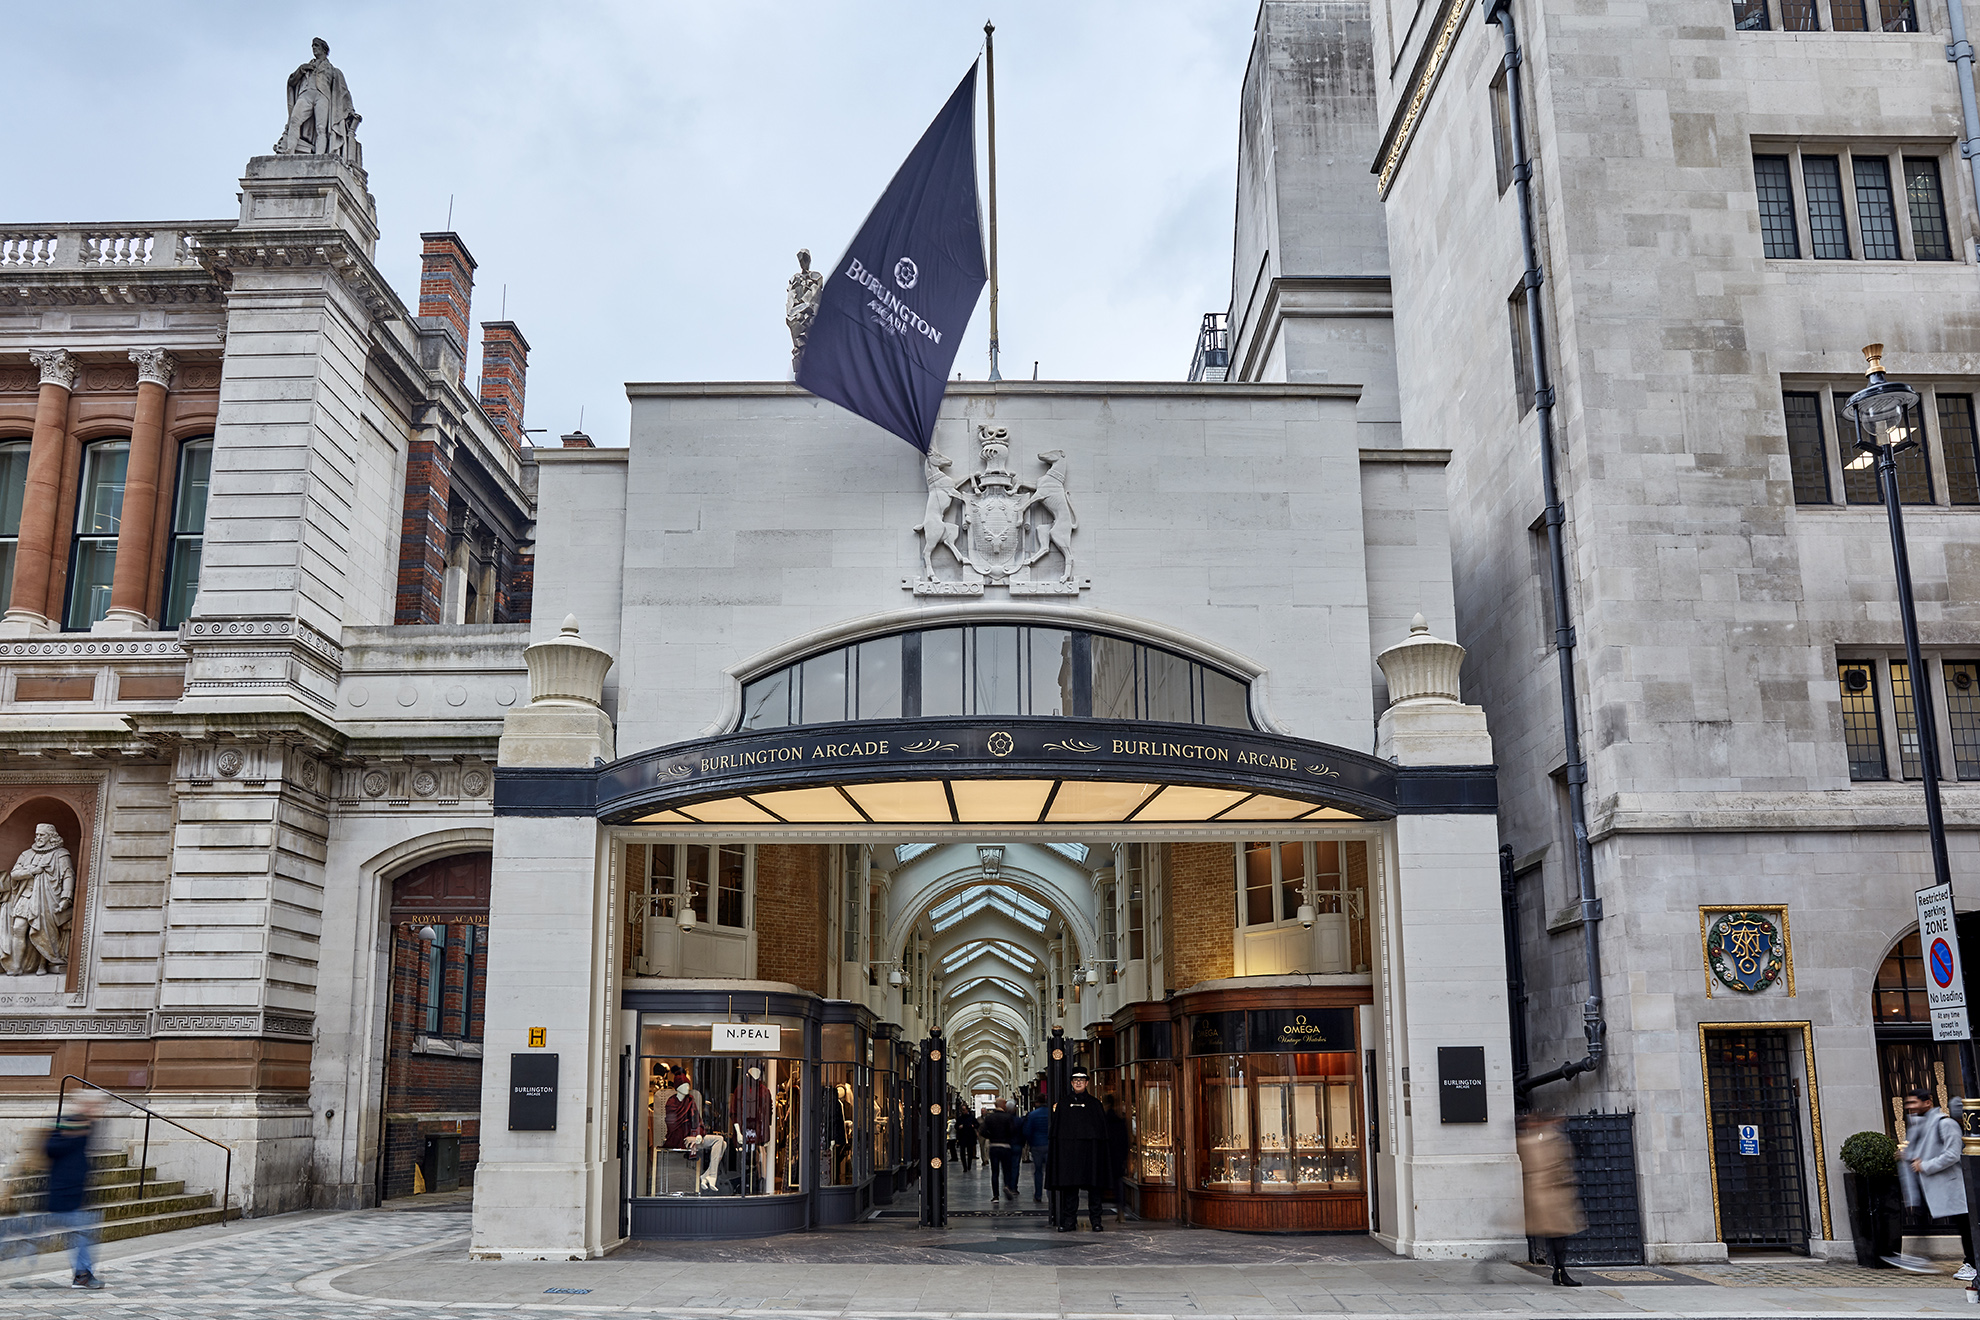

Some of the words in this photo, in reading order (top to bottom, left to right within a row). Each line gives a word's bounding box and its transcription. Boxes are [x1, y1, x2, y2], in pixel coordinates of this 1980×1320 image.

[845, 257, 943, 344] BURLINGTON
[917, 583, 980, 593] CAVENDO
[1016, 583, 1073, 593] TUTUS
[223, 665, 256, 675] DAVY
[700, 746, 803, 773] BURLINGTON
[811, 740, 889, 760] ARCADE
[1112, 739, 1229, 762] BURLINGTON
[1236, 750, 1297, 772] ARCADE
[1918, 889, 1949, 906] Restricted
[1924, 905, 1946, 920] parking
[412, 915, 442, 923] ROYAL
[1925, 919, 1949, 935] ZONE
[1930, 993, 1939, 1004] No
[1940, 991, 1963, 1003] loading
[1283, 1025, 1320, 1034] OMEGA
[1940, 1021, 1954, 1029] except
[531, 1029, 543, 1044] H
[726, 1029, 769, 1038] N.PEAL
[1277, 1034, 1301, 1045] Vintage
[1939, 1030, 1952, 1038] signed
